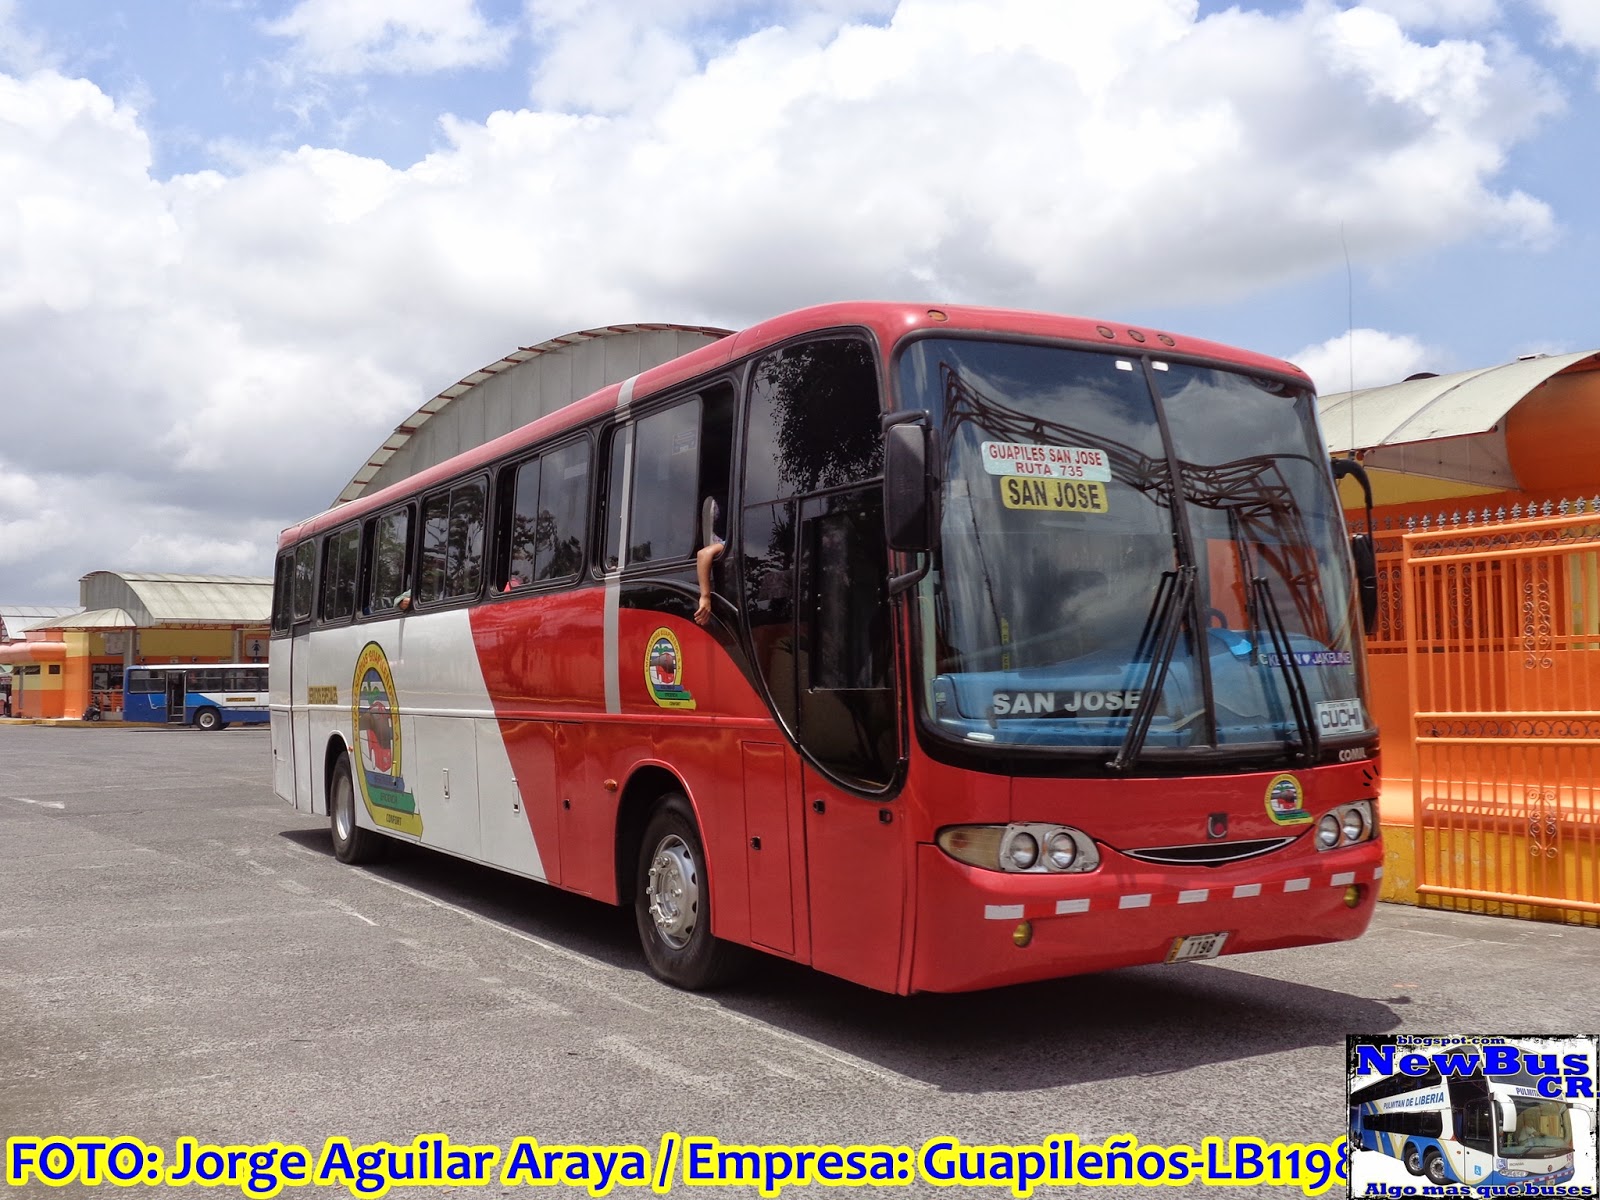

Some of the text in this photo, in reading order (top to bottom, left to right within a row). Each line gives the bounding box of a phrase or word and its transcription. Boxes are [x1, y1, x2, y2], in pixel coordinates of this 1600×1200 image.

[989, 444, 1102, 466] GUAPILES SAN JOSE
[1015, 462, 1083, 477] RUTA 735
[1008, 478, 1101, 509] SAN JOSE
[993, 690, 1142, 715] SAN JOSE
[1320, 708, 1361, 729] CUCHI
[1338, 747, 1367, 762] COMIL
[1186, 940, 1216, 956] 1198
